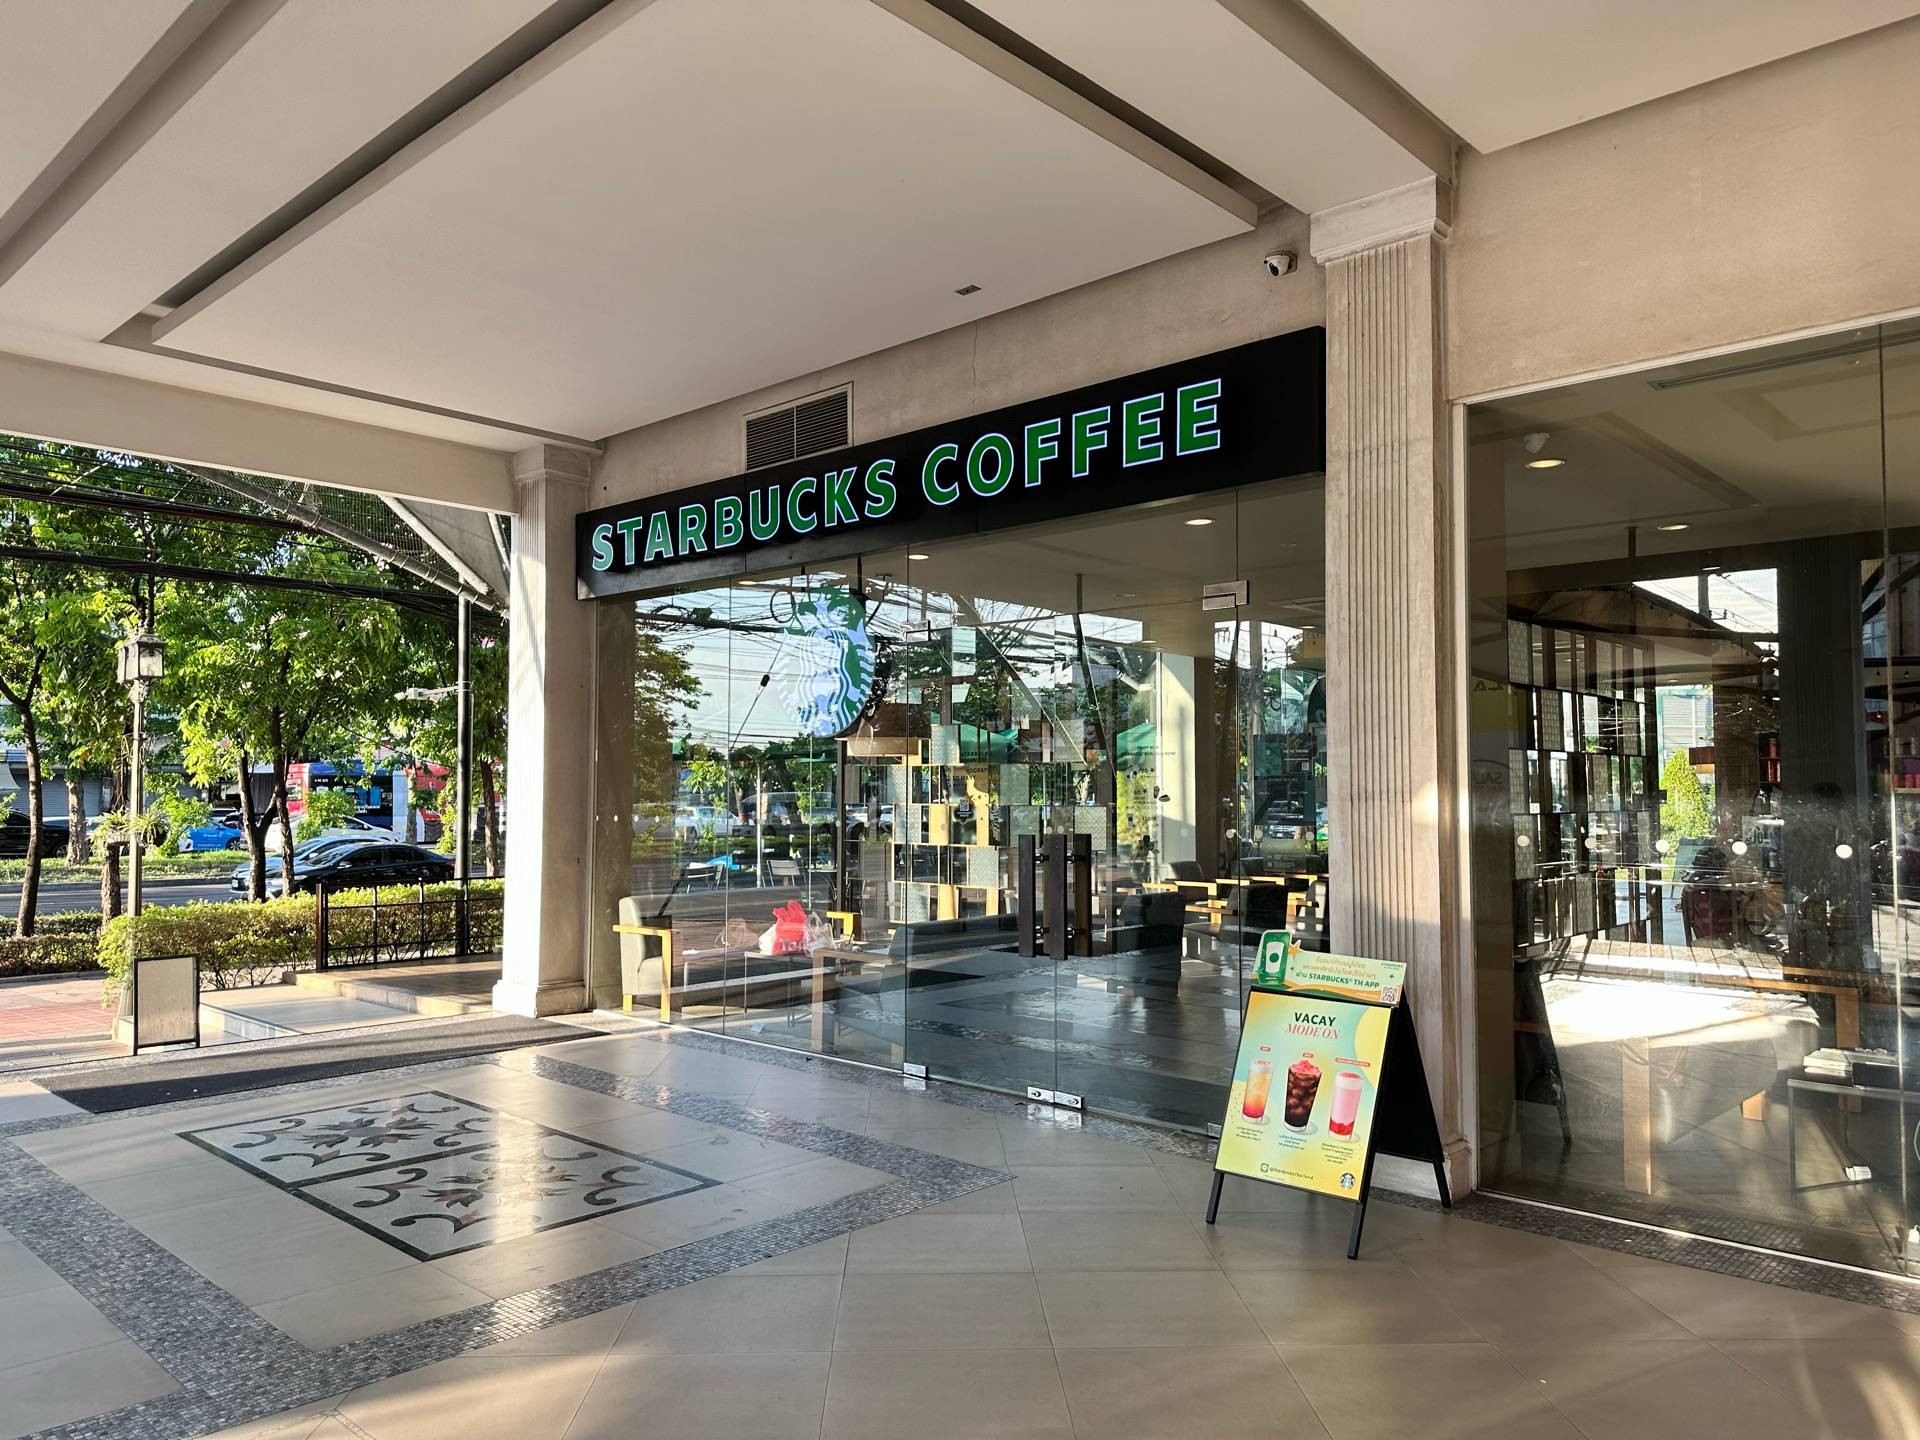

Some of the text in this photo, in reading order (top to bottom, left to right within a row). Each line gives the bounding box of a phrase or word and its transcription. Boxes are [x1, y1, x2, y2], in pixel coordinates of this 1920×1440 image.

[591, 378, 1223, 573] STARBUCKS COFFEE
[1364, 979, 1380, 989] APP
[1294, 1011, 1337, 1027] VACAY
[1285, 1023, 1341, 1040] MODE ON
